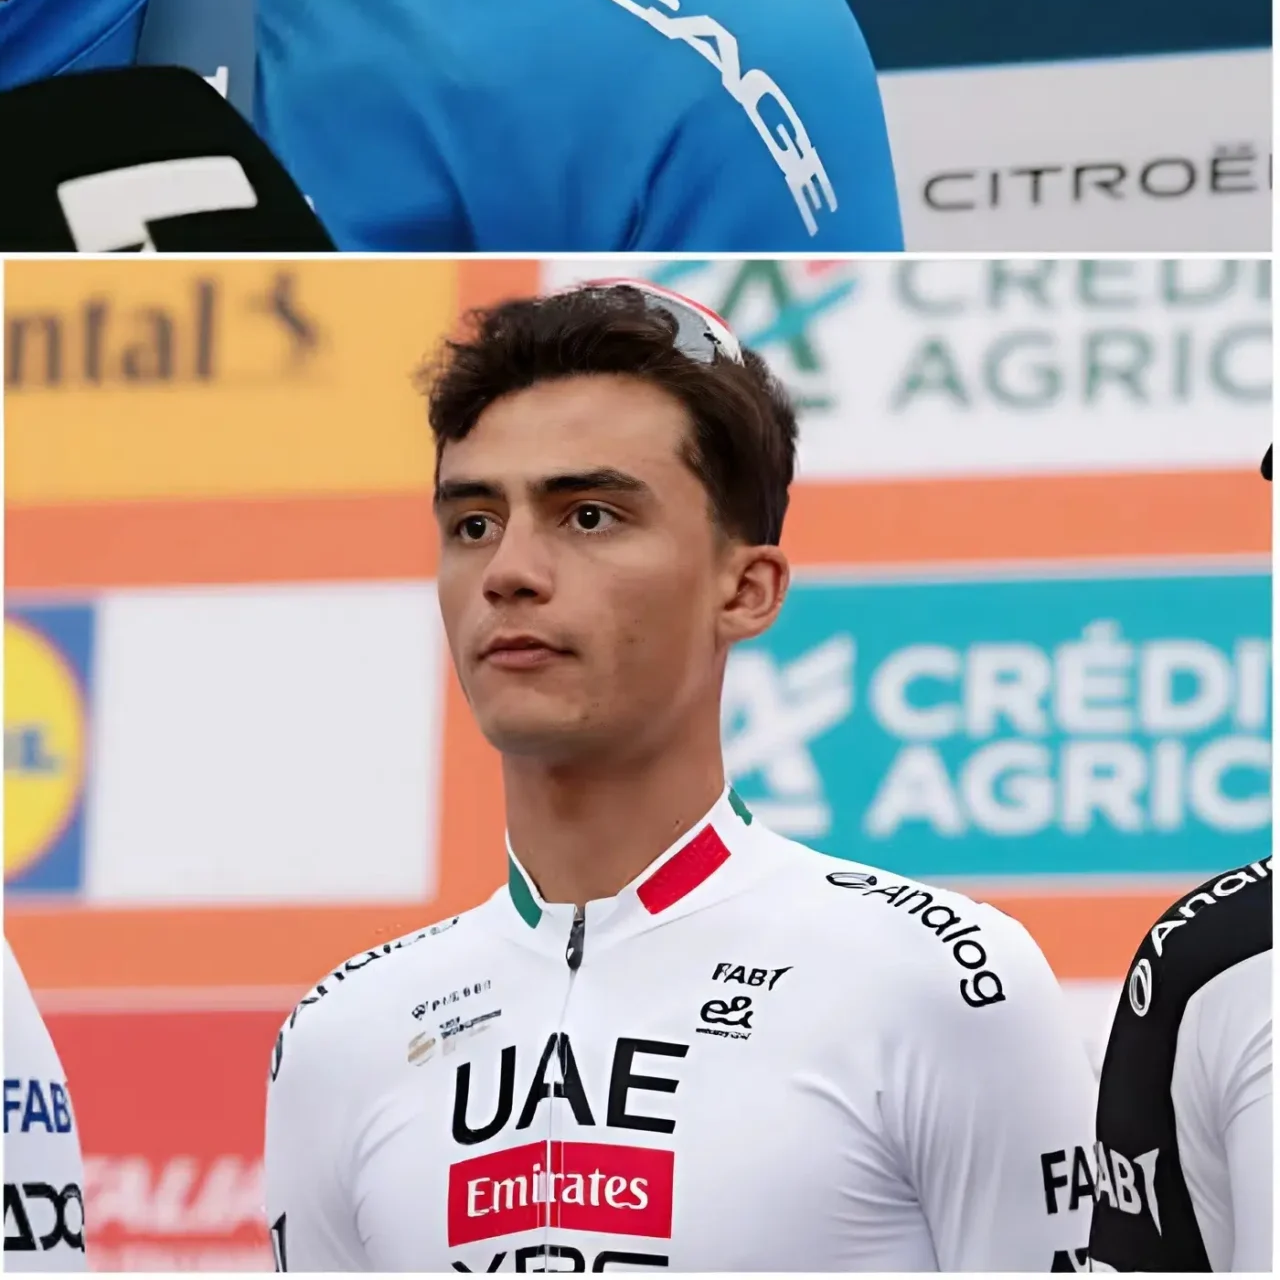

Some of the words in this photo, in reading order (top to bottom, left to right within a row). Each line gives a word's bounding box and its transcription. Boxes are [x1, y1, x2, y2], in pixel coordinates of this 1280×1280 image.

[923, 144, 1273, 211] CITROË
[892, 323, 1272, 412] AGRIC
[865, 734, 1272, 838] AGRIC
[862, 885, 1006, 1007] Analog
[1151, 858, 1272, 957] Anal
[451, 1032, 690, 1146] UAE
[467, 1162, 649, 1218] Emirates
